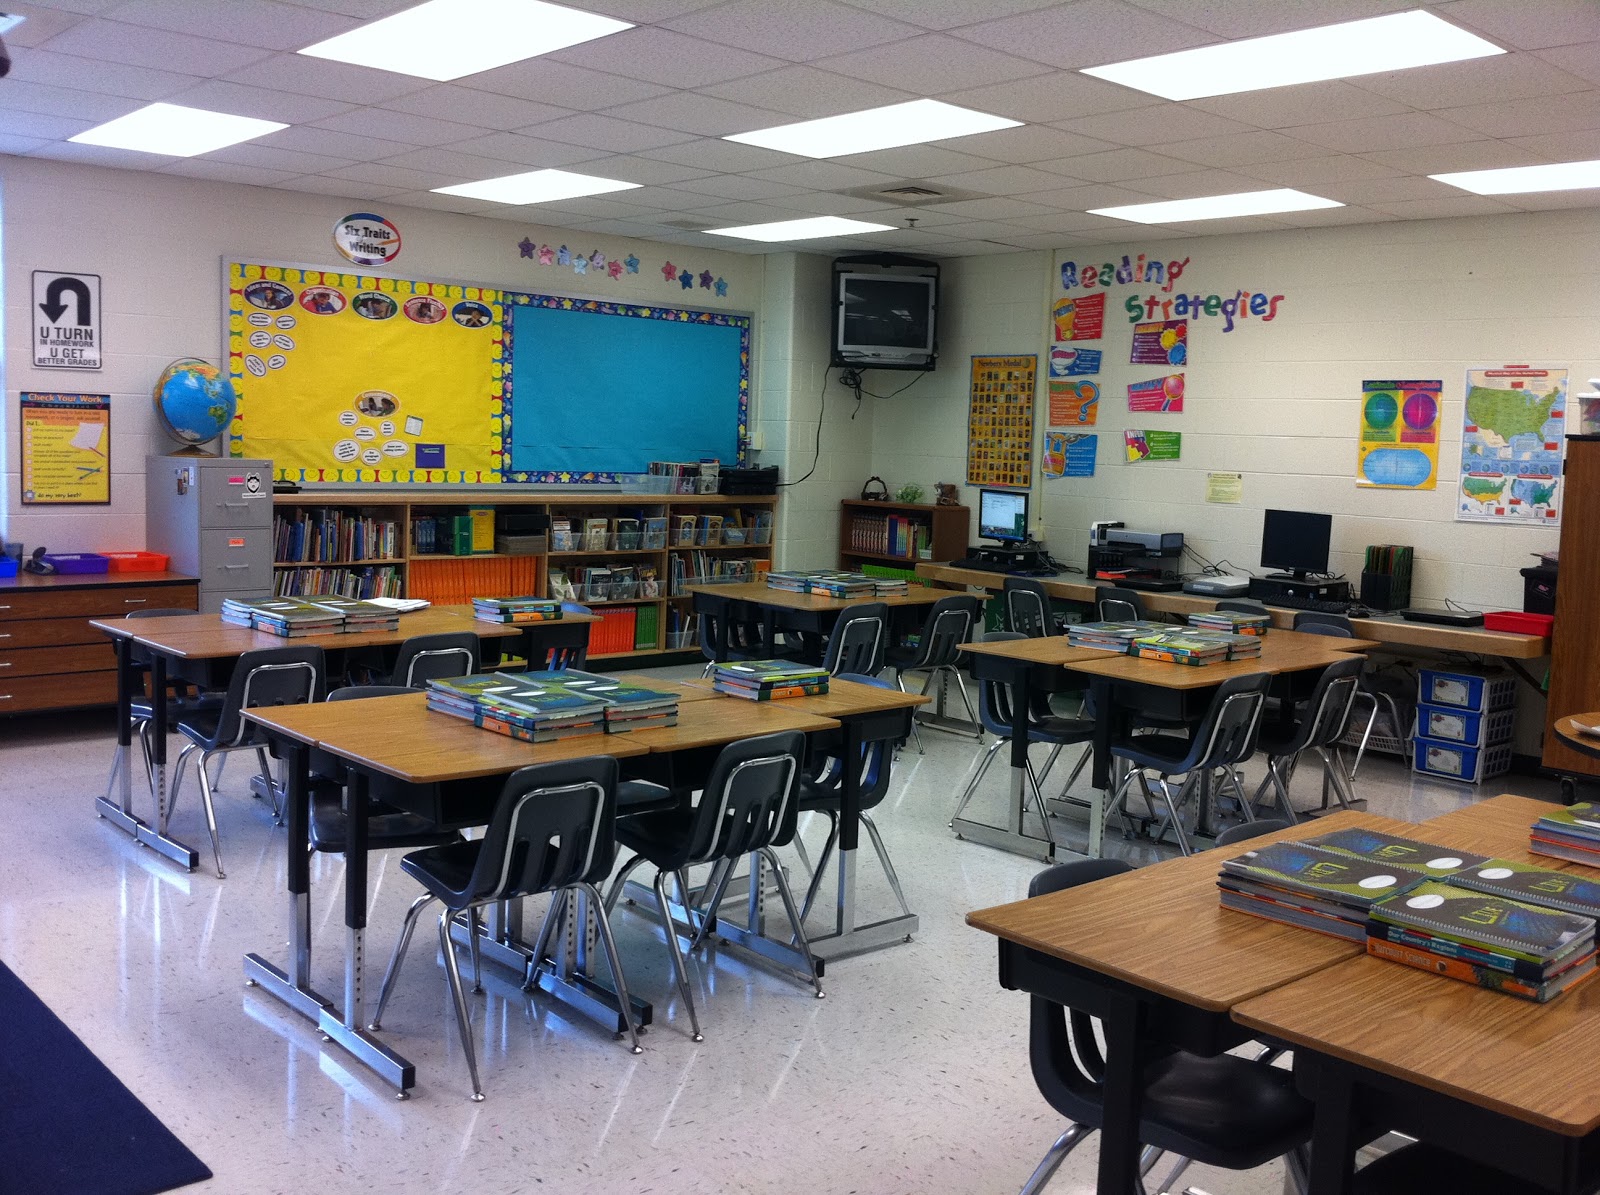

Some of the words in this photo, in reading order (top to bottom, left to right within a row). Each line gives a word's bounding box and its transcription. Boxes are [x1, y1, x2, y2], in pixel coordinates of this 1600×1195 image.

[345, 225, 360, 236] Six
[363, 227, 390, 239] Traits
[349, 241, 386, 257] Writing
[1061, 253, 1190, 293] Reading
[1125, 289, 1285, 333] Strategies
[40, 326, 49, 339] U
[54, 327, 93, 340] TURN
[50, 339, 94, 347] HOMEWORK
[50, 347, 58, 357] U
[62, 348, 84, 358] GET
[37, 357, 65, 365] BETTER
[68, 358, 97, 366] GRADES
[28, 393, 55, 401] Check
[56, 394, 76, 402] Your
[80, 395, 102, 403] Work
[1387, 930, 1402, 939] Our
[1402, 932, 1431, 948] Country's
[1431, 940, 1457, 954] Regions
